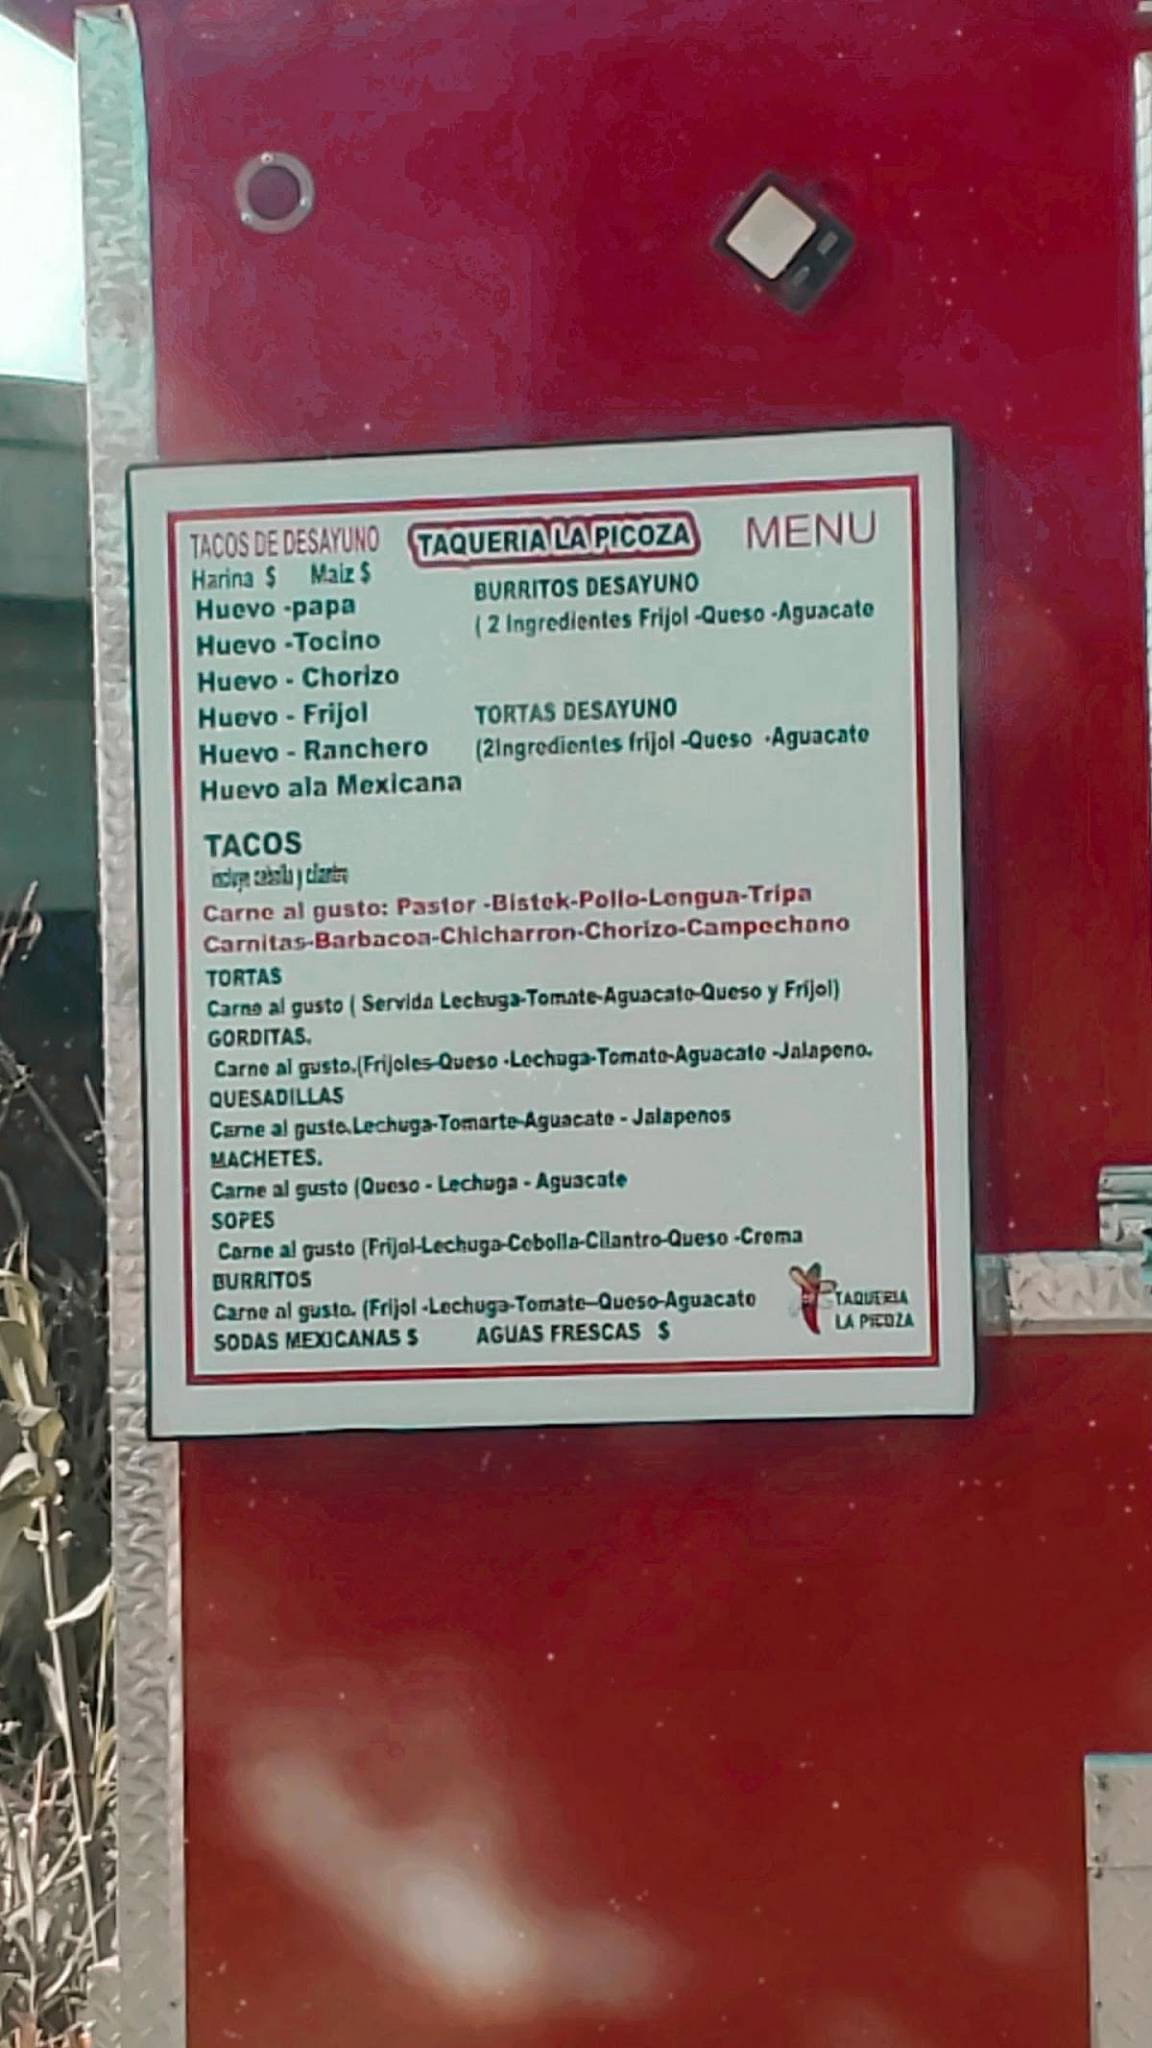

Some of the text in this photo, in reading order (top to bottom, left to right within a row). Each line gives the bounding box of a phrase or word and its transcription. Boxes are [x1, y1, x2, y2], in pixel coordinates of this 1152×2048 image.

[417, 521, 690, 556] TAQUERIA LA PICOZA
[746, 509, 877, 549] MENU
[190, 525, 380, 559] TACOS DE DESAYUNO
[192, 566, 277, 590] Harina $
[311, 561, 371, 584] Maiz $
[473, 572, 699, 601] BURRITOS DESAYUNO
[196, 598, 275, 620] Huevo
[507, 610, 632, 636] Ingredientes
[639, 608, 689, 631] Frijol
[694, 605, 765, 626] -Queso
[196, 630, 381, 656] Huevo -Tocino
[197, 671, 278, 693] Huevo
[302, 664, 400, 689] Chorizo
[198, 708, 278, 729] Huevo
[303, 701, 369, 729] Frijol
[474, 697, 677, 725] TORTAS DESAYUNO
[199, 744, 278, 765] Huevo
[304, 737, 428, 761] Ranchero
[629, 732, 676, 755] frijol
[200, 773, 463, 801] Huevo ala Mexicana
[203, 831, 302, 858] TACOS
[203, 903, 274, 923] Carne
[284, 901, 304, 920] al
[313, 901, 388, 924] gusto:
[397, 898, 477, 916] Pastor
[205, 967, 282, 988] TORTAS
[207, 999, 262, 1018] Carne
[269, 997, 285, 1016] al
[291, 998, 343, 1019] gusto
[361, 993, 433, 1013] Servida
[768, 982, 778, 1005] y
[785, 978, 840, 1002] Frijol)
[208, 1027, 311, 1048] GORDITAS.
[214, 1060, 269, 1078] Carne
[275, 1058, 292, 1076] al
[209, 1087, 344, 1108] QUESADILLAS
[210, 1120, 265, 1139] Carne
[270, 1119, 287, 1138] al
[632, 1106, 731, 1131] Jalapenos
[210, 1148, 323, 1169] MACHETES.
[210, 1181, 266, 1200] Carne
[273, 1180, 288, 1199] al
[296, 1180, 348, 1201] gusto
[355, 1176, 419, 1200] (Queso
[438, 1173, 518, 1195] Lechuga
[535, 1171, 628, 1194] Aguacate
[211, 1211, 275, 1230] SOPES
[218, 1242, 274, 1260] Carne
[280, 1240, 296, 1259] al
[303, 1241, 355, 1263] gusto
[212, 1270, 312, 1291] BURRITOS
[835, 1290, 908, 1305] TAQUERIA
[213, 1303, 269, 1322] Carne
[275, 1300, 292, 1320] al
[363, 1298, 417, 1322] (Frijol
[835, 1313, 854, 1330] LA
[214, 1332, 279, 1352] SODAS
[286, 1328, 401, 1350] MEXICANAS
[476, 1321, 671, 1345] AGUAS FRESCAS $
